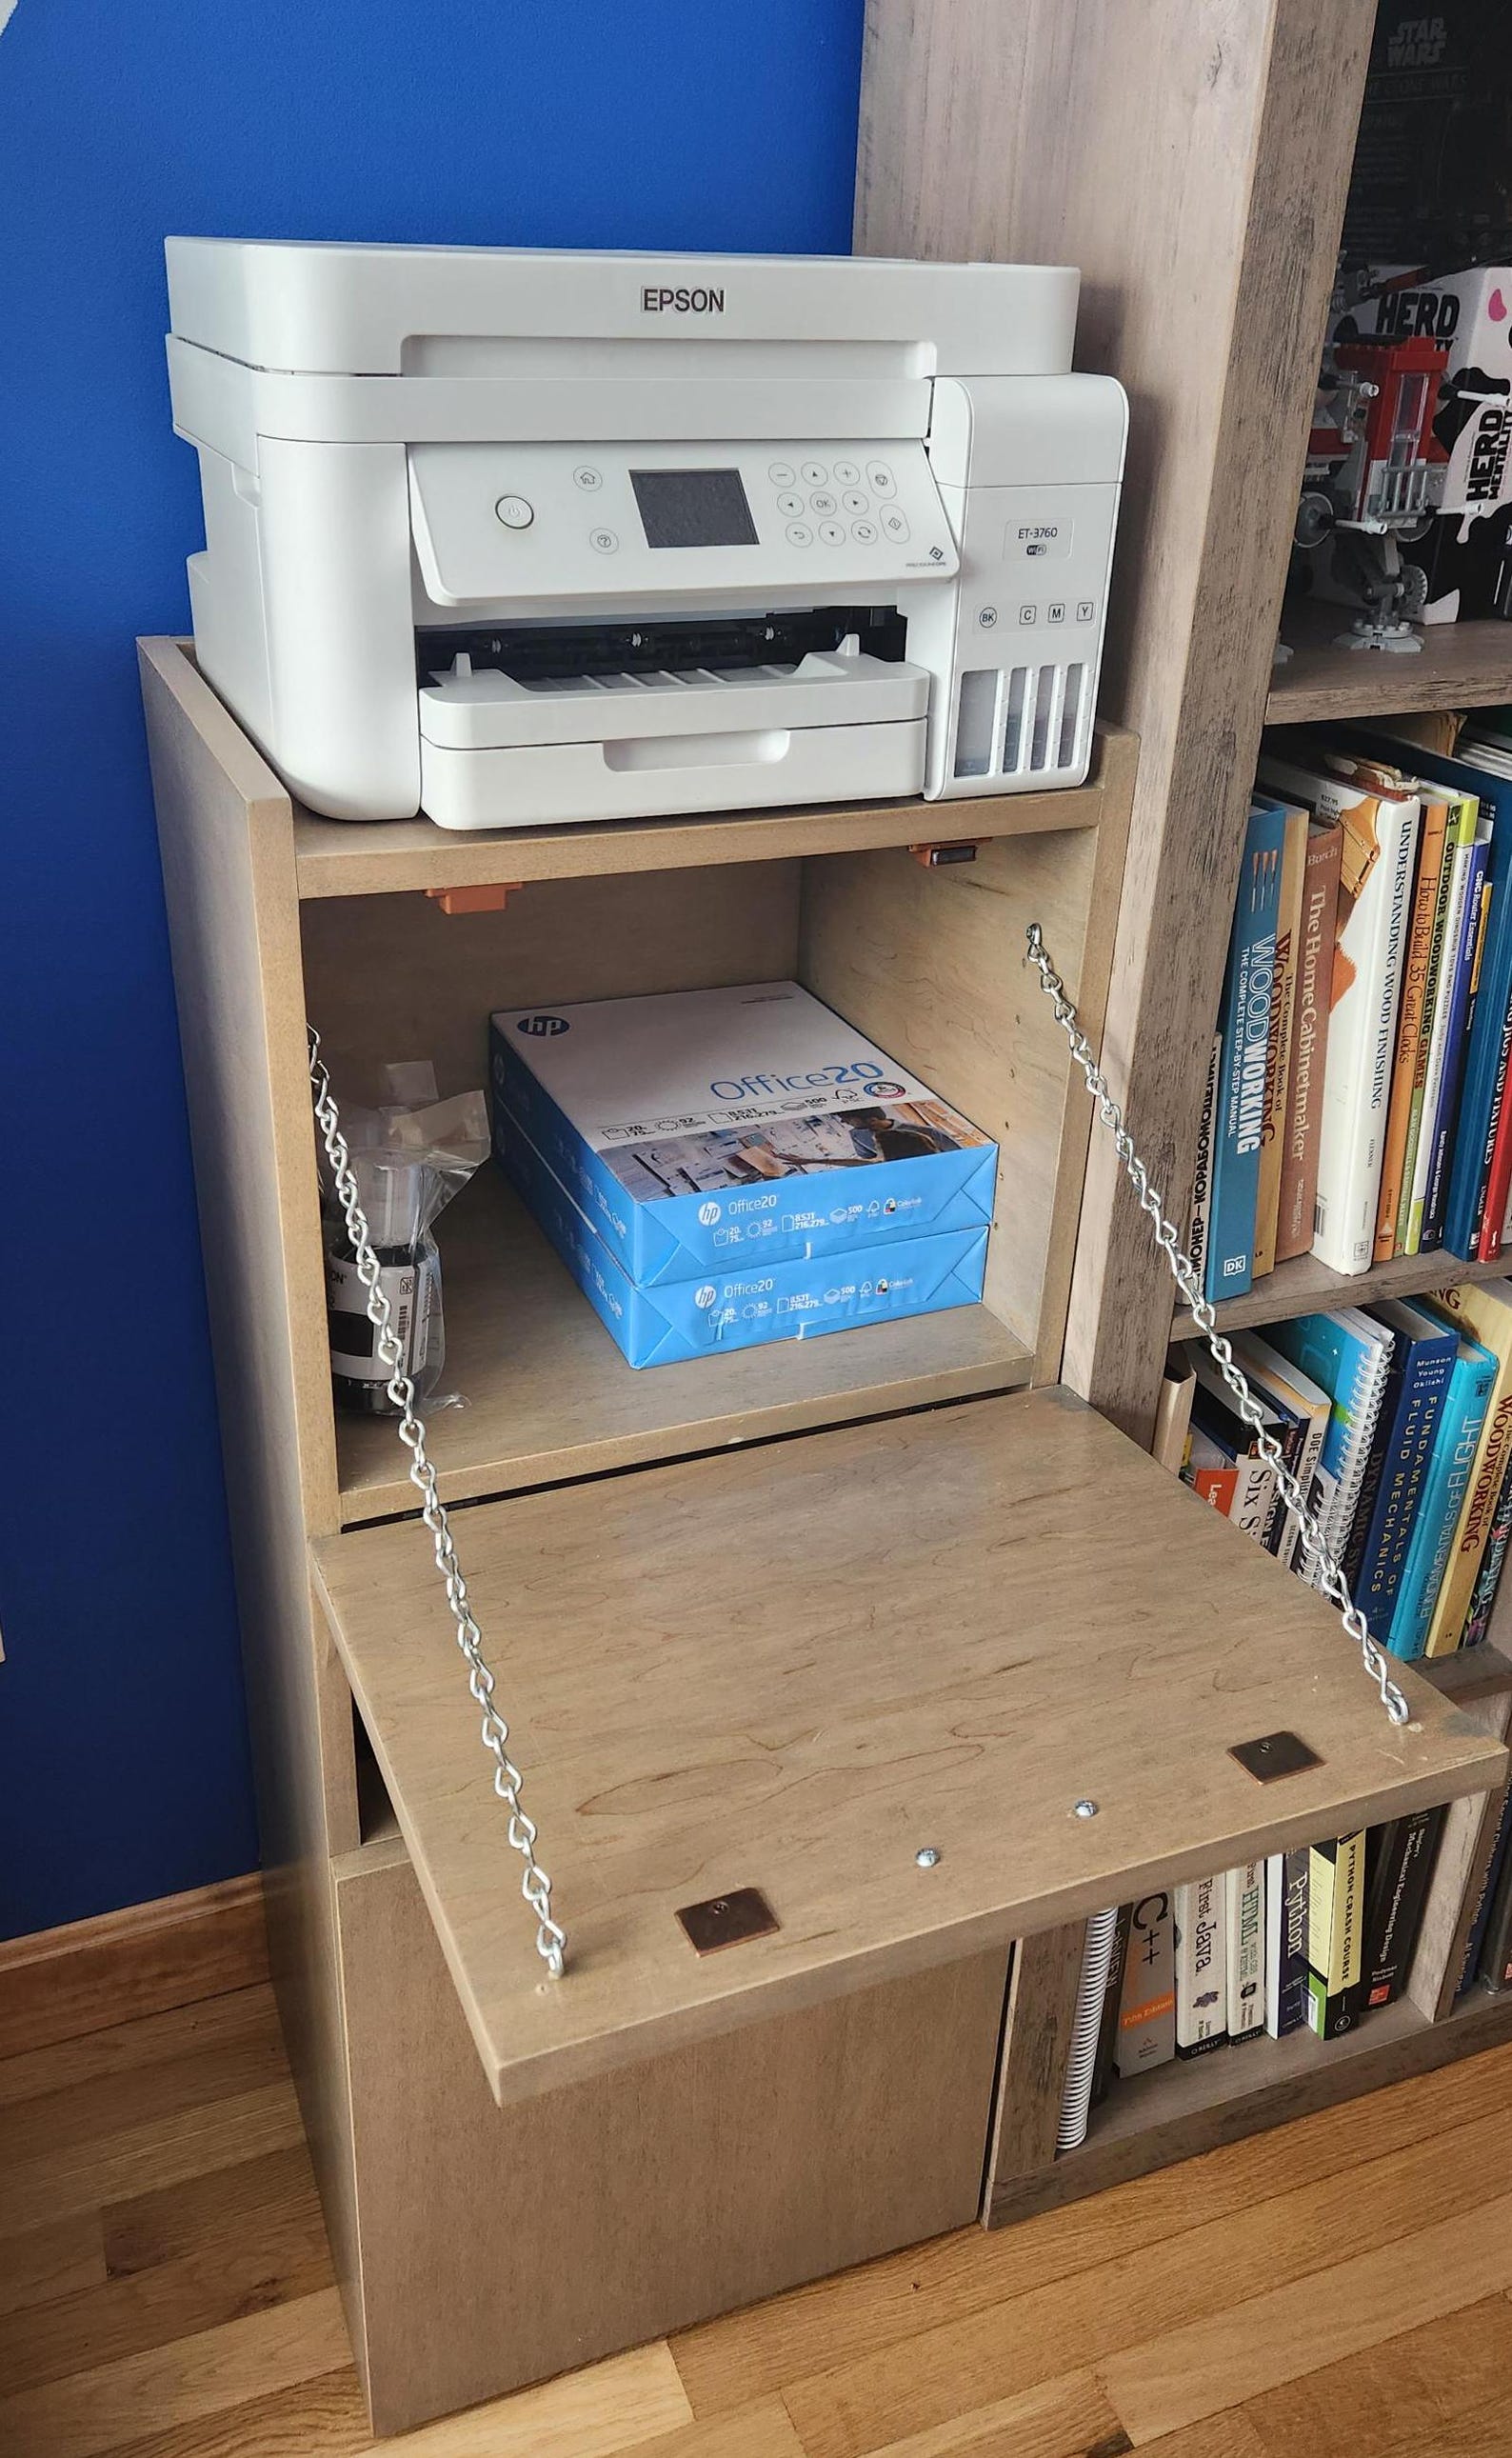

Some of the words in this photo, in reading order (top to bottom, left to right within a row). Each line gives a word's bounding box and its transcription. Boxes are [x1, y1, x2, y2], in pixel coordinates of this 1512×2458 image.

[1383, 16, 1447, 45] STAR
[1387, 42, 1446, 68] WARS
[644, 289, 725, 312] EPSON
[1377, 291, 1461, 338] HERD
[1465, 410, 1502, 501] HERD
[1018, 527, 1058, 540] ET-3760
[982, 612, 995, 623] BK
[1024, 610, 1032, 620] C
[1052, 609, 1062, 618] M
[1082, 607, 1089, 616] Y
[1307, 847, 1338, 866] Burch
[1386, 820, 1412, 968] UNDERSTANDING
[1419, 876, 1437, 911] How
[1437, 842, 1455, 916] OUTDOOR
[1474, 870, 1484, 893] CNC
[1307, 884, 1326, 933] The
[1416, 913, 1430, 925] to
[1469, 893, 1480, 920] Router
[1240, 947, 1250, 969] THE
[1411, 926, 1431, 959] Build
[1463, 922, 1477, 961] Essentials
[1301, 934, 1322, 1007] Home
[1408, 963, 1427, 982] 35
[1422, 919, 1445, 1035] WOODWORKING
[1235, 970, 1248, 1025] COMPLETE
[1381, 971, 1395, 1025] WOOD
[1404, 985, 1423, 1021] Great
[527, 1015, 562, 1036] hp
[1237, 932, 1277, 1156] WOODWORKING
[1280, 1001, 1291, 1062] Complete
[1399, 1023, 1419, 1064] Clocks
[1231, 1026, 1244, 1092] STEP-BY-STEP
[1371, 1029, 1389, 1109] FINISHING
[1414, 1038, 1428, 1089] GAMES
[1496, 1060, 1507, 1092] AND
[710, 1061, 884, 1101] Office20
[1276, 1064, 1285, 1100] Book
[1291, 1008, 1317, 1162] Cabinetmaker
[1227, 1095, 1239, 1138] MANUAL
[1483, 1096, 1503, 1166] FIXTURES
[728, 1194, 778, 1215] Office20
[1226, 1258, 1243, 1272] DK
[724, 1278, 773, 1299] Office20
[1416, 1356, 1452, 1368] Munson
[1418, 1368, 1444, 1378] Young
[1309, 1432, 1323, 1452] DOE
[1400, 1399, 1422, 1461] FLUID
[1447, 1414, 1483, 1489] FLIGHT
[1491, 1443, 1509, 1491] Complete
[1243, 1469, 1272, 1508] Six
[1393, 1395, 1438, 1563] FUNDAMENTALS
[1461, 1393, 1512, 1553] WOODWORKING
[1484, 1491, 1498, 1514] Book
[1371, 1472, 1405, 1592] MECHANICS
[1386, 1574, 1397, 1596] OF
[1346, 1844, 1357, 1894] PYTHON
[1398, 1832, 1416, 1882] Mechanical
[1198, 1878, 1213, 1918] First
[1241, 1885, 1260, 1946] HTML
[1284, 1871, 1308, 1959] Python
[1343, 1895, 1354, 1936] CRASH
[1384, 1883, 1405, 1933] Engineering
[1133, 1891, 1168, 1966] C++
[1196, 1921, 1217, 1973] Java
[1379, 1933, 1394, 1963] Design
[1341, 1937, 1353, 1982] COURSE
